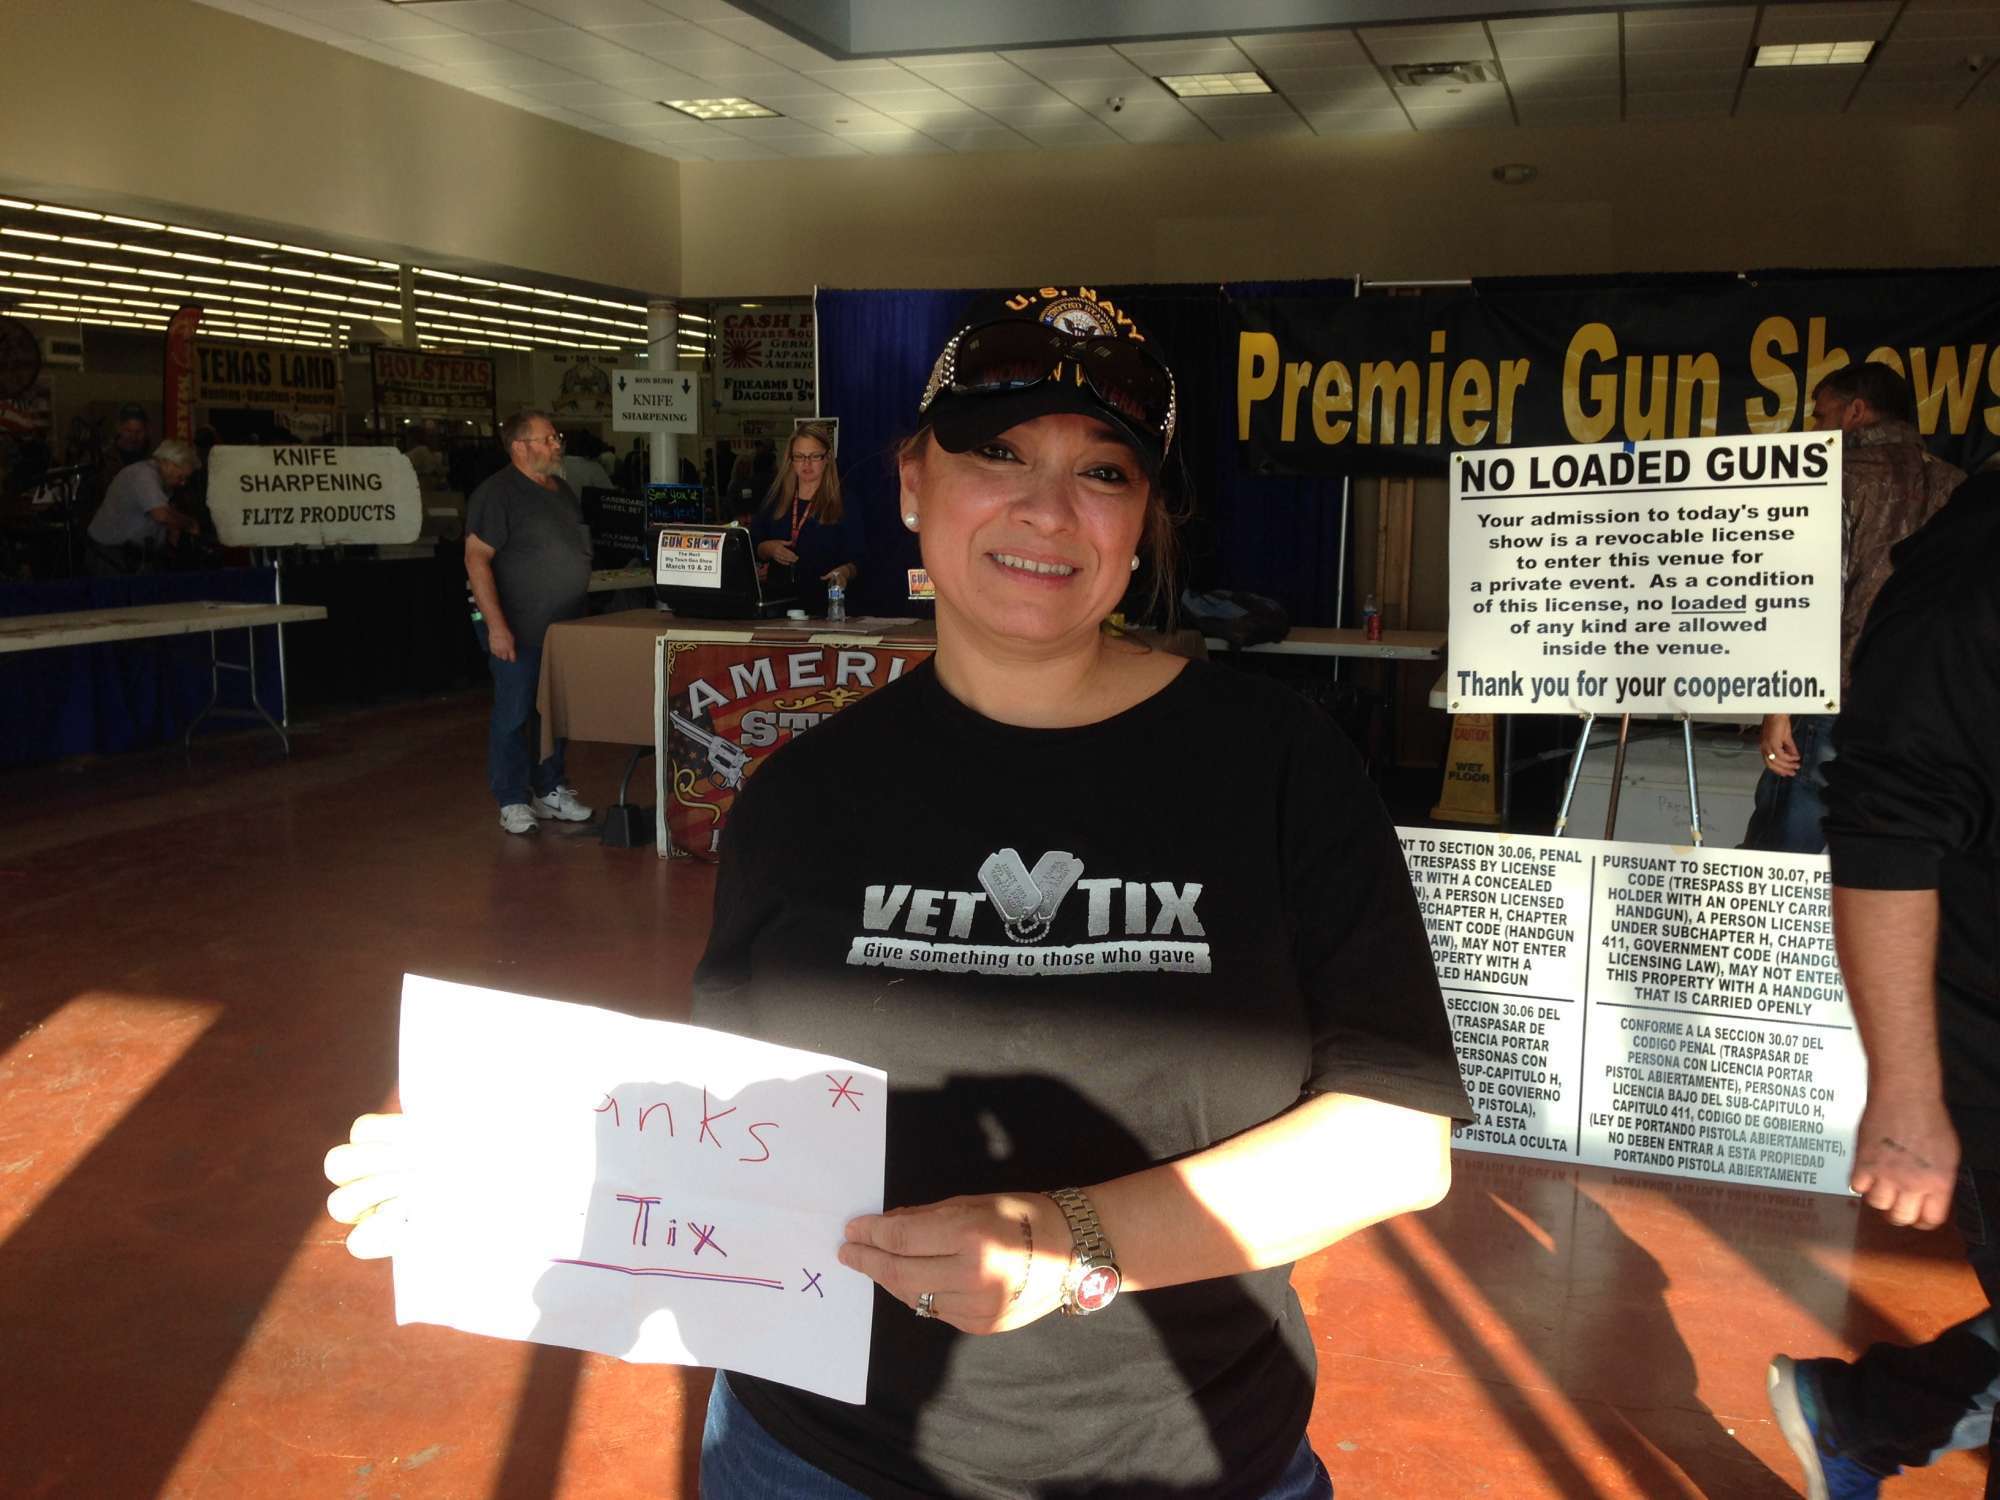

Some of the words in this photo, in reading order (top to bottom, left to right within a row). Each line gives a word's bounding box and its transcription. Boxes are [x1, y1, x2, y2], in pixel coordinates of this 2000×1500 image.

[723, 314, 791, 328] CASH
[1079, 286, 1145, 341] NAVY
[198, 349, 271, 386] TEXAS
[279, 352, 336, 390] LAND
[378, 352, 489, 384] HOLSTERS
[1237, 330, 1531, 446] Premier
[1562, 322, 1720, 443] Gun
[633, 394, 674, 407] KNIFE
[622, 412, 688, 422] SHARPENING
[273, 448, 337, 466] KNIFE
[1461, 459, 1514, 493] NO
[1530, 450, 1690, 489] LOADED
[1707, 443, 1828, 481] GUNS
[240, 473, 383, 492] SHARPENING
[242, 508, 294, 525] FLITZ
[300, 504, 396, 524] PRODUCTS
[1477, 514, 1524, 528] Your
[1530, 509, 1640, 526] admission
[1647, 508, 1669, 522] to
[1677, 504, 1759, 523] today's
[1767, 506, 1809, 522] gun
[662, 535, 683, 548] GUN
[1489, 535, 1543, 549] show
[1551, 533, 1568, 547] is
[1575, 536, 1587, 546] a
[1596, 529, 1704, 545] revocable
[1712, 528, 1795, 542] license
[1516, 556, 1537, 569] to
[1544, 555, 1602, 568] enter
[1609, 552, 1650, 567] this
[1657, 553, 1724, 566] venue
[1731, 549, 1764, 564] for
[1470, 581, 1482, 592] a
[1490, 577, 1562, 595] private
[1569, 575, 1635, 590] event.
[1649, 574, 1678, 588] As
[1685, 576, 1698, 587] a
[1706, 571, 1814, 587] condition
[1473, 599, 1493, 613] of
[1499, 599, 1538, 613] this
[1546, 598, 1629, 614] license,
[1637, 600, 1663, 610] no
[1671, 595, 1746, 610] loaded
[1755, 597, 1810, 613] guns
[1510, 620, 1531, 634] of
[1536, 623, 1574, 637] any
[1582, 619, 1627, 633] kind
[1635, 621, 1671, 632] are
[1678, 617, 1767, 632] allowed
[1543, 641, 1607, 655] inside
[1614, 641, 1649, 655] the
[1656, 643, 1730, 656] venue.
[1457, 670, 1523, 696] Thank
[1531, 677, 1569, 704] you
[1577, 670, 1608, 696] for
[1616, 677, 1667, 704] your
[1674, 670, 1825, 704] cooperation.
[1448, 770, 1490, 784] FLOOR
[1456, 761, 1484, 772] WET
[1419, 840, 1435, 852] TO
[1440, 841, 1494, 856] SECTION
[1498, 845, 1535, 861] 30.06,
[1540, 848, 1582, 863] PENAL
[1409, 855, 1476, 870] (TRESPASS
[1480, 860, 1497, 872] BY
[1502, 862, 1556, 877] LICENSE
[1603, 855, 1676, 872] PURSUANT
[1680, 861, 1698, 874] TO
[1703, 862, 1763, 878] SECTION
[1768, 867, 1808, 884] 30.07,
[1427, 872, 1458, 884] WITH
[1462, 874, 1470, 886] A
[1475, 875, 1552, 892] CONCEALED
[1628, 873, 1664, 887] CODE
[1669, 876, 1743, 893] (TRESPASS
[1748, 883, 1767, 895] BY
[1772, 884, 1830, 901] LICENSE
[863, 885, 987, 938] VET
[1077, 878, 1206, 937] TIX
[1433, 888, 1441, 899] A
[1446, 888, 1496, 904] PERSON
[1501, 893, 1564, 909] LICENSED
[1608, 887, 1662, 903] HOLDER
[1667, 892, 1701, 907] WITH
[1706, 896, 1725, 908] AN
[1730, 898, 1784, 913] OPENLY
[1616, 904, 1692, 924] HANDGUN),
[1696, 911, 1706, 923] A
[1710, 912, 1766, 928] PERSON
[863, 942, 904, 960] Give
[909, 949, 1010, 969] something
[1017, 954, 1036, 967] to
[1042, 951, 1095, 968] those
[1101, 947, 1142, 964] who
[1149, 947, 1195, 966] gave
[1447, 998, 1499, 1014] SECCION
[1503, 1004, 1534, 1017] 30.06
[1538, 1008, 1560, 1020] DEL
[1453, 1015, 1526, 1033] (TRASPASAR
[1530, 1023, 1545, 1035] DE
[1620, 1018, 1683, 1035] CONFORME
[1686, 1024, 1694, 1036] A
[1697, 1025, 1711, 1038] LA
[1715, 1027, 1764, 1043] SECCION
[1769, 1033, 1798, 1046] 30.07
[1802, 1036, 1824, 1050] DEL
[1502, 1036, 1549, 1052] PORTAR
[1633, 1035, 1676, 1051] CODIGO
[1680, 1040, 1716, 1055] PENAL
[1720, 1045, 1790, 1063] (TRASPASAR
[1794, 1052, 1808, 1065] DE
